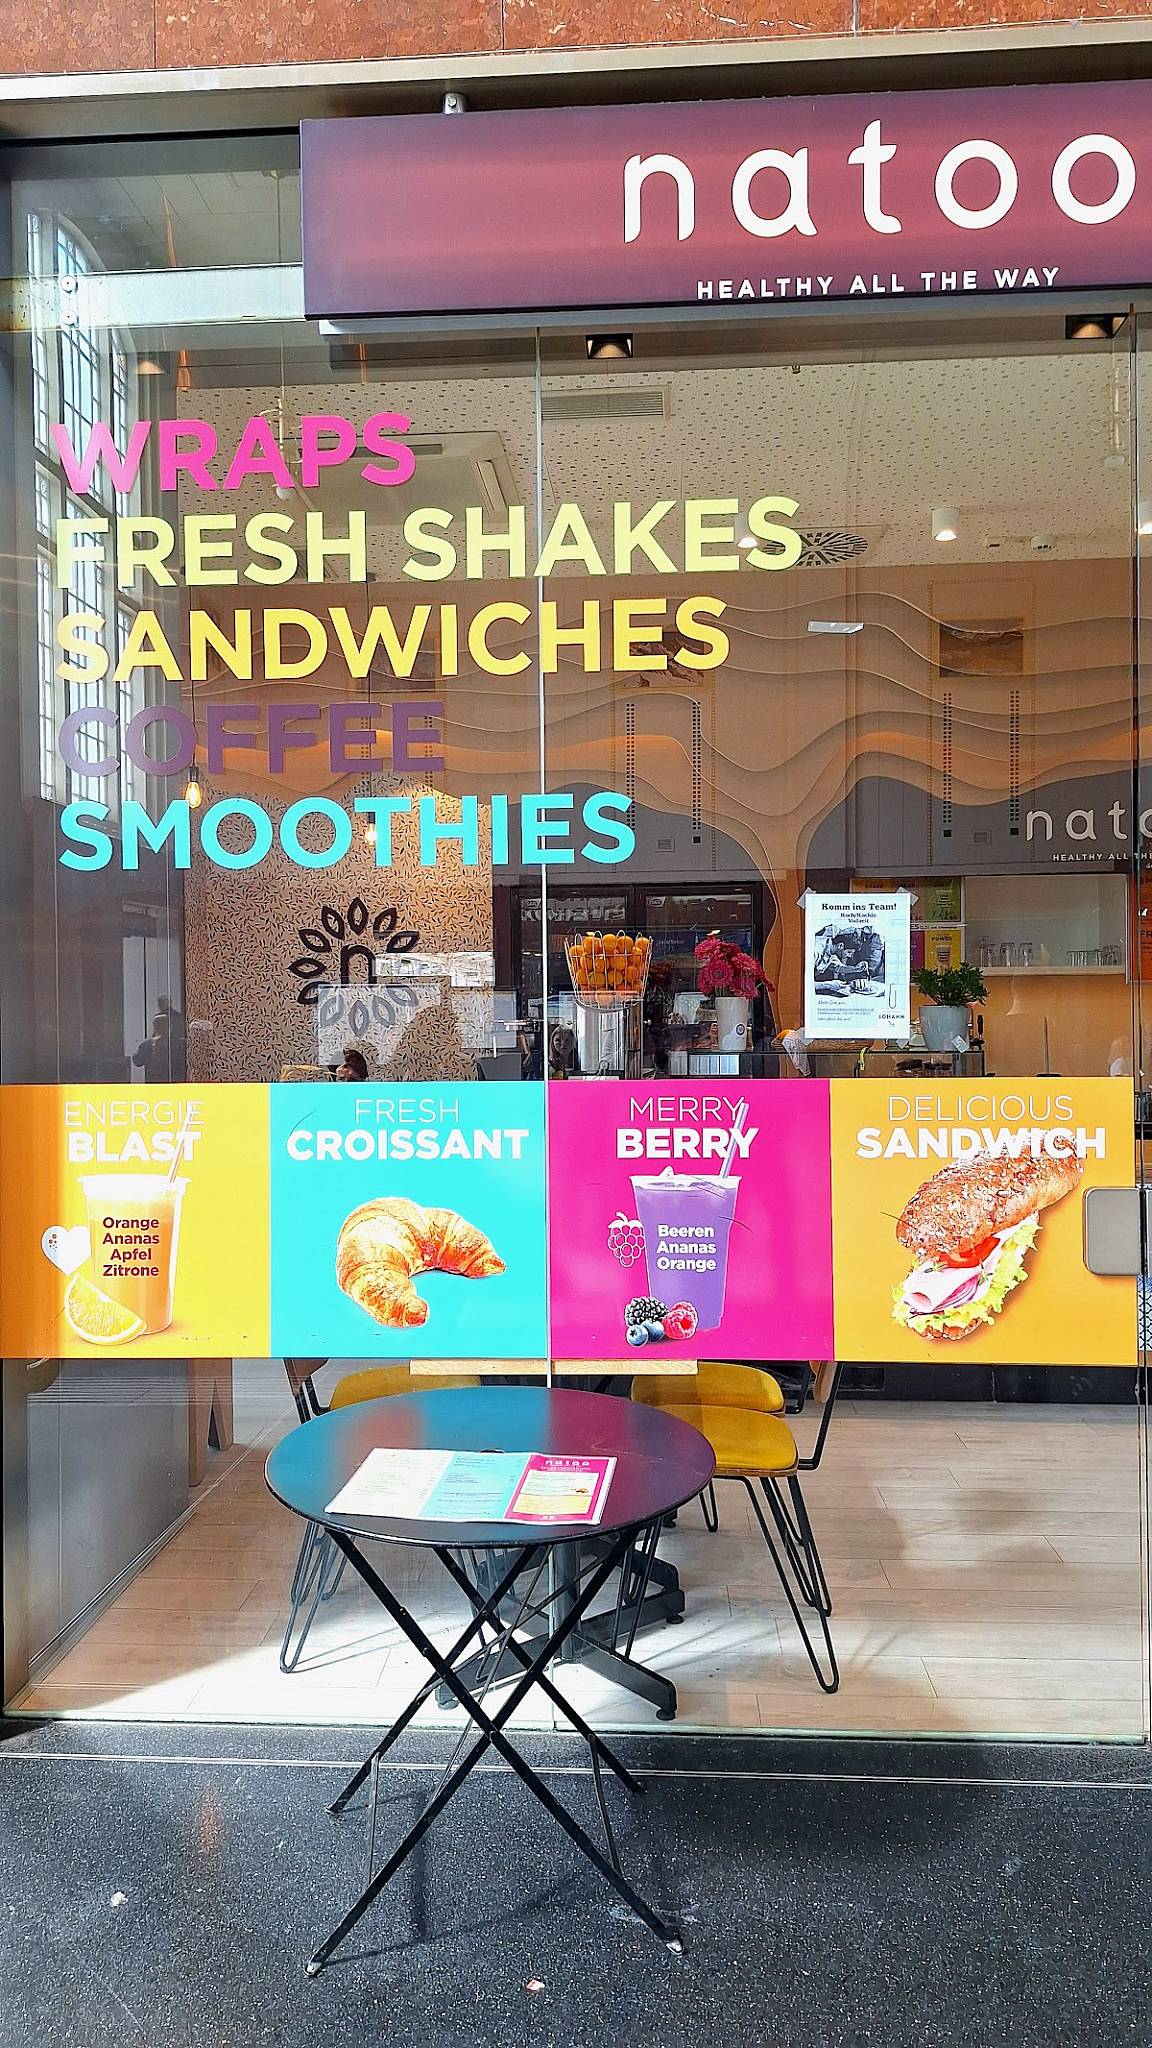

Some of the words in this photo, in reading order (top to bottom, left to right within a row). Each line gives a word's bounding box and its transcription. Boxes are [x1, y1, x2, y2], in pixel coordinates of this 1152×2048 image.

[624, 119, 1136, 243] natoo
[697, 275, 834, 300] HEALTHY
[850, 274, 904, 294] ALL
[921, 270, 978, 291] THE
[994, 266, 1060, 288] WAY
[51, 412, 417, 494] WRAPS
[55, 510, 367, 589] FRESH
[402, 496, 803, 582] SHAKES
[55, 596, 730, 684] SANDWICHES
[58, 701, 445, 777] COFFEE
[58, 791, 636, 871] SMOOTHIES
[1053, 852, 1103, 861] HEALTHY
[1109, 852, 1129, 860] ALL
[821, 903, 851, 911] Komm
[852, 903, 867, 911] ins
[868, 903, 897, 911] Team!
[64, 1100, 205, 1126] ENERGIE
[354, 1098, 459, 1124] FRESH
[630, 1096, 745, 1122] MERRY
[888, 1095, 1074, 1121] DELICIOUS
[68, 1130, 202, 1162] BLAST
[286, 1129, 530, 1161] CROISSANT
[616, 1127, 759, 1159] BERRY
[855, 1127, 1106, 1160] SANDWICH
[102, 1216, 160, 1231] Orange
[658, 1224, 715, 1238] Beeren
[102, 1232, 160, 1245] Ananas
[656, 1240, 717, 1254] Ananas
[110, 1247, 152, 1262] Apfel
[656, 1256, 717, 1273] Orange
[102, 1264, 160, 1277] Zitrone
